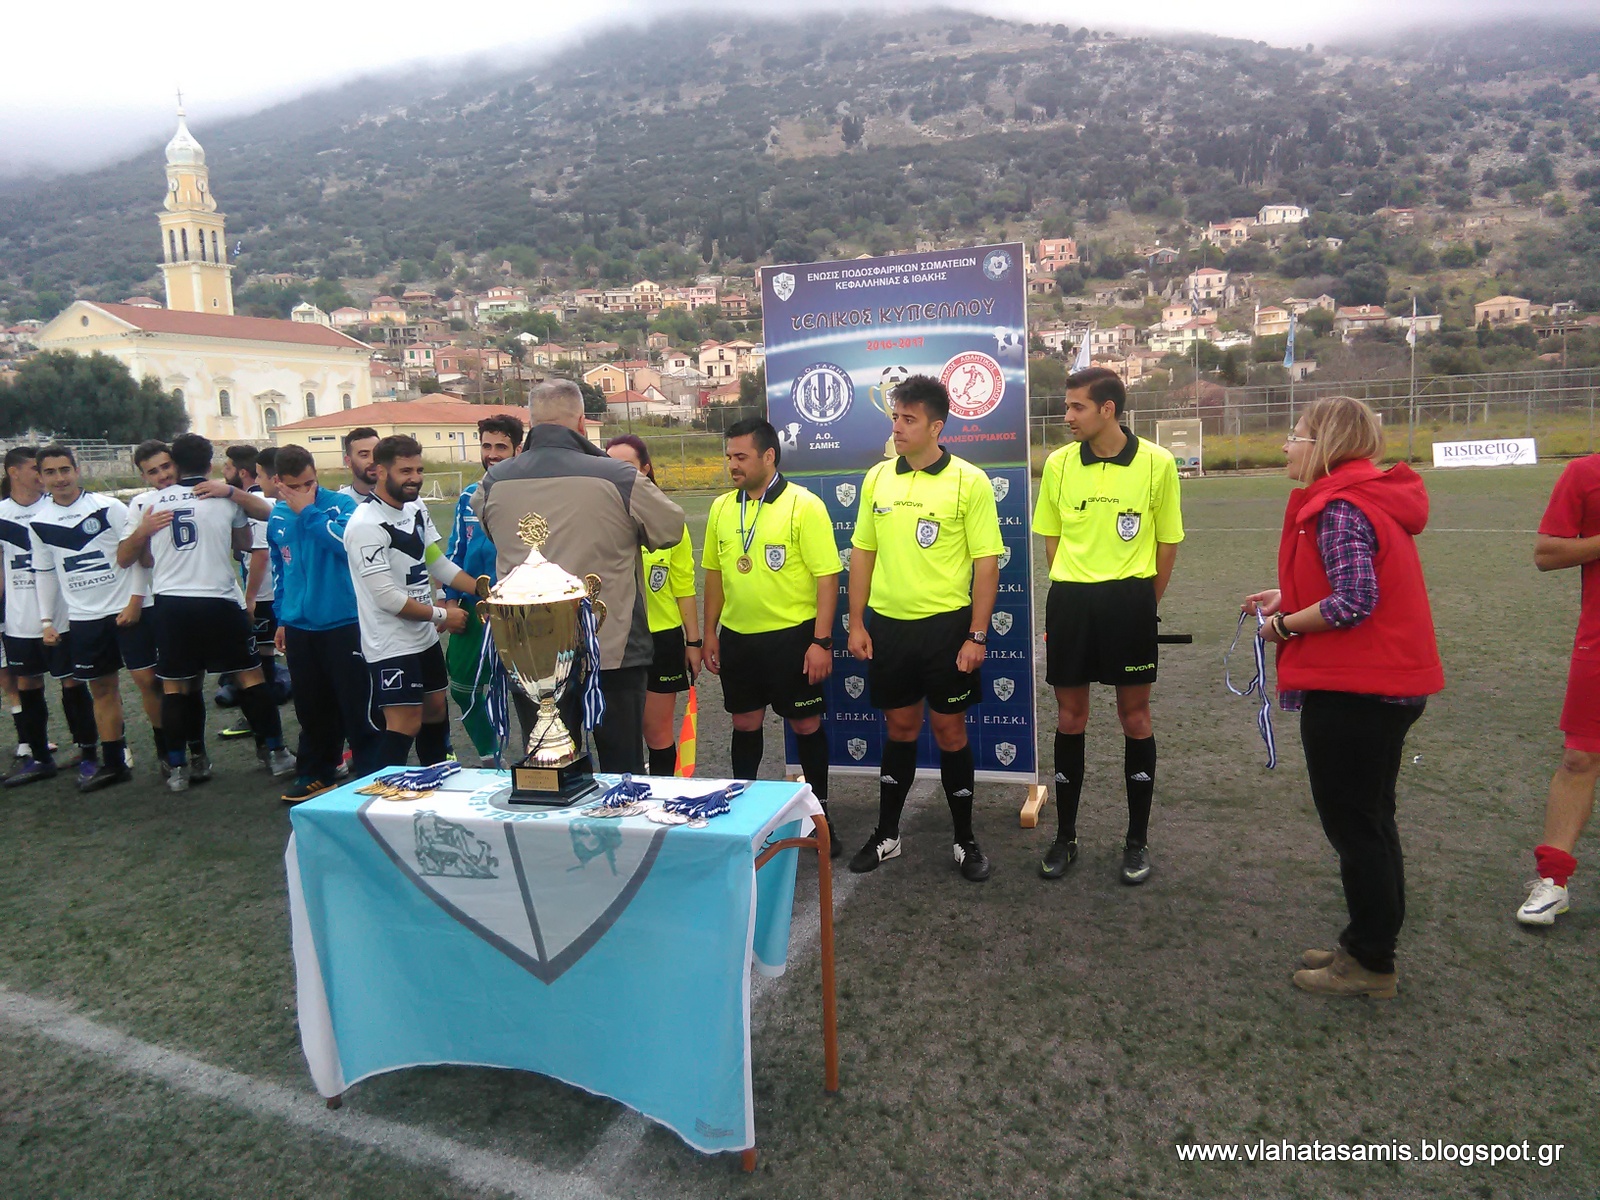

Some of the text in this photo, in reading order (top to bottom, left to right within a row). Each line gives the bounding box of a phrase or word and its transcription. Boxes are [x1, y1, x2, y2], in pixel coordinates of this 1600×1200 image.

[807, 270, 840, 282] ΕΝΩΣΙΣ
[841, 263, 919, 279] ΠΟΔΟΣΦΑΙΡΙΚΩΝ
[920, 257, 977, 272] ΣΩΜΑΤΕΙΩΝ
[835, 271, 947, 290] ΚΕΦΑΛΛΗΝΙΑΣ & ΙΘΑΚΗΣ
[878, 297, 995, 324] ΚΥΠΕΛΛΟΥ
[866, 336, 925, 351] 2016-2017
[962, 424, 982, 433] Α.Ο.
[815, 432, 834, 440] Α.Ο.
[938, 431, 1017, 444] ΑΛΛΗΞΟΥΡΙΑΚΟΣ
[809, 441, 840, 450] ΣΑΜΗΣ
[893, 500, 924, 508] GIVOVA
[1087, 496, 1119, 504] GIVOVA
[169, 507, 199, 552] 6
[68, 573, 116, 589] STEFATOU
[1124, 662, 1156, 672] GIVOVA
[794, 696, 823, 707] GIVOVA
[836, 712, 877, 722] Ε.Π.Σ.Κ.Ι.
[983, 715, 1028, 725] Ε.Π.Σ.Κ.Ι.
